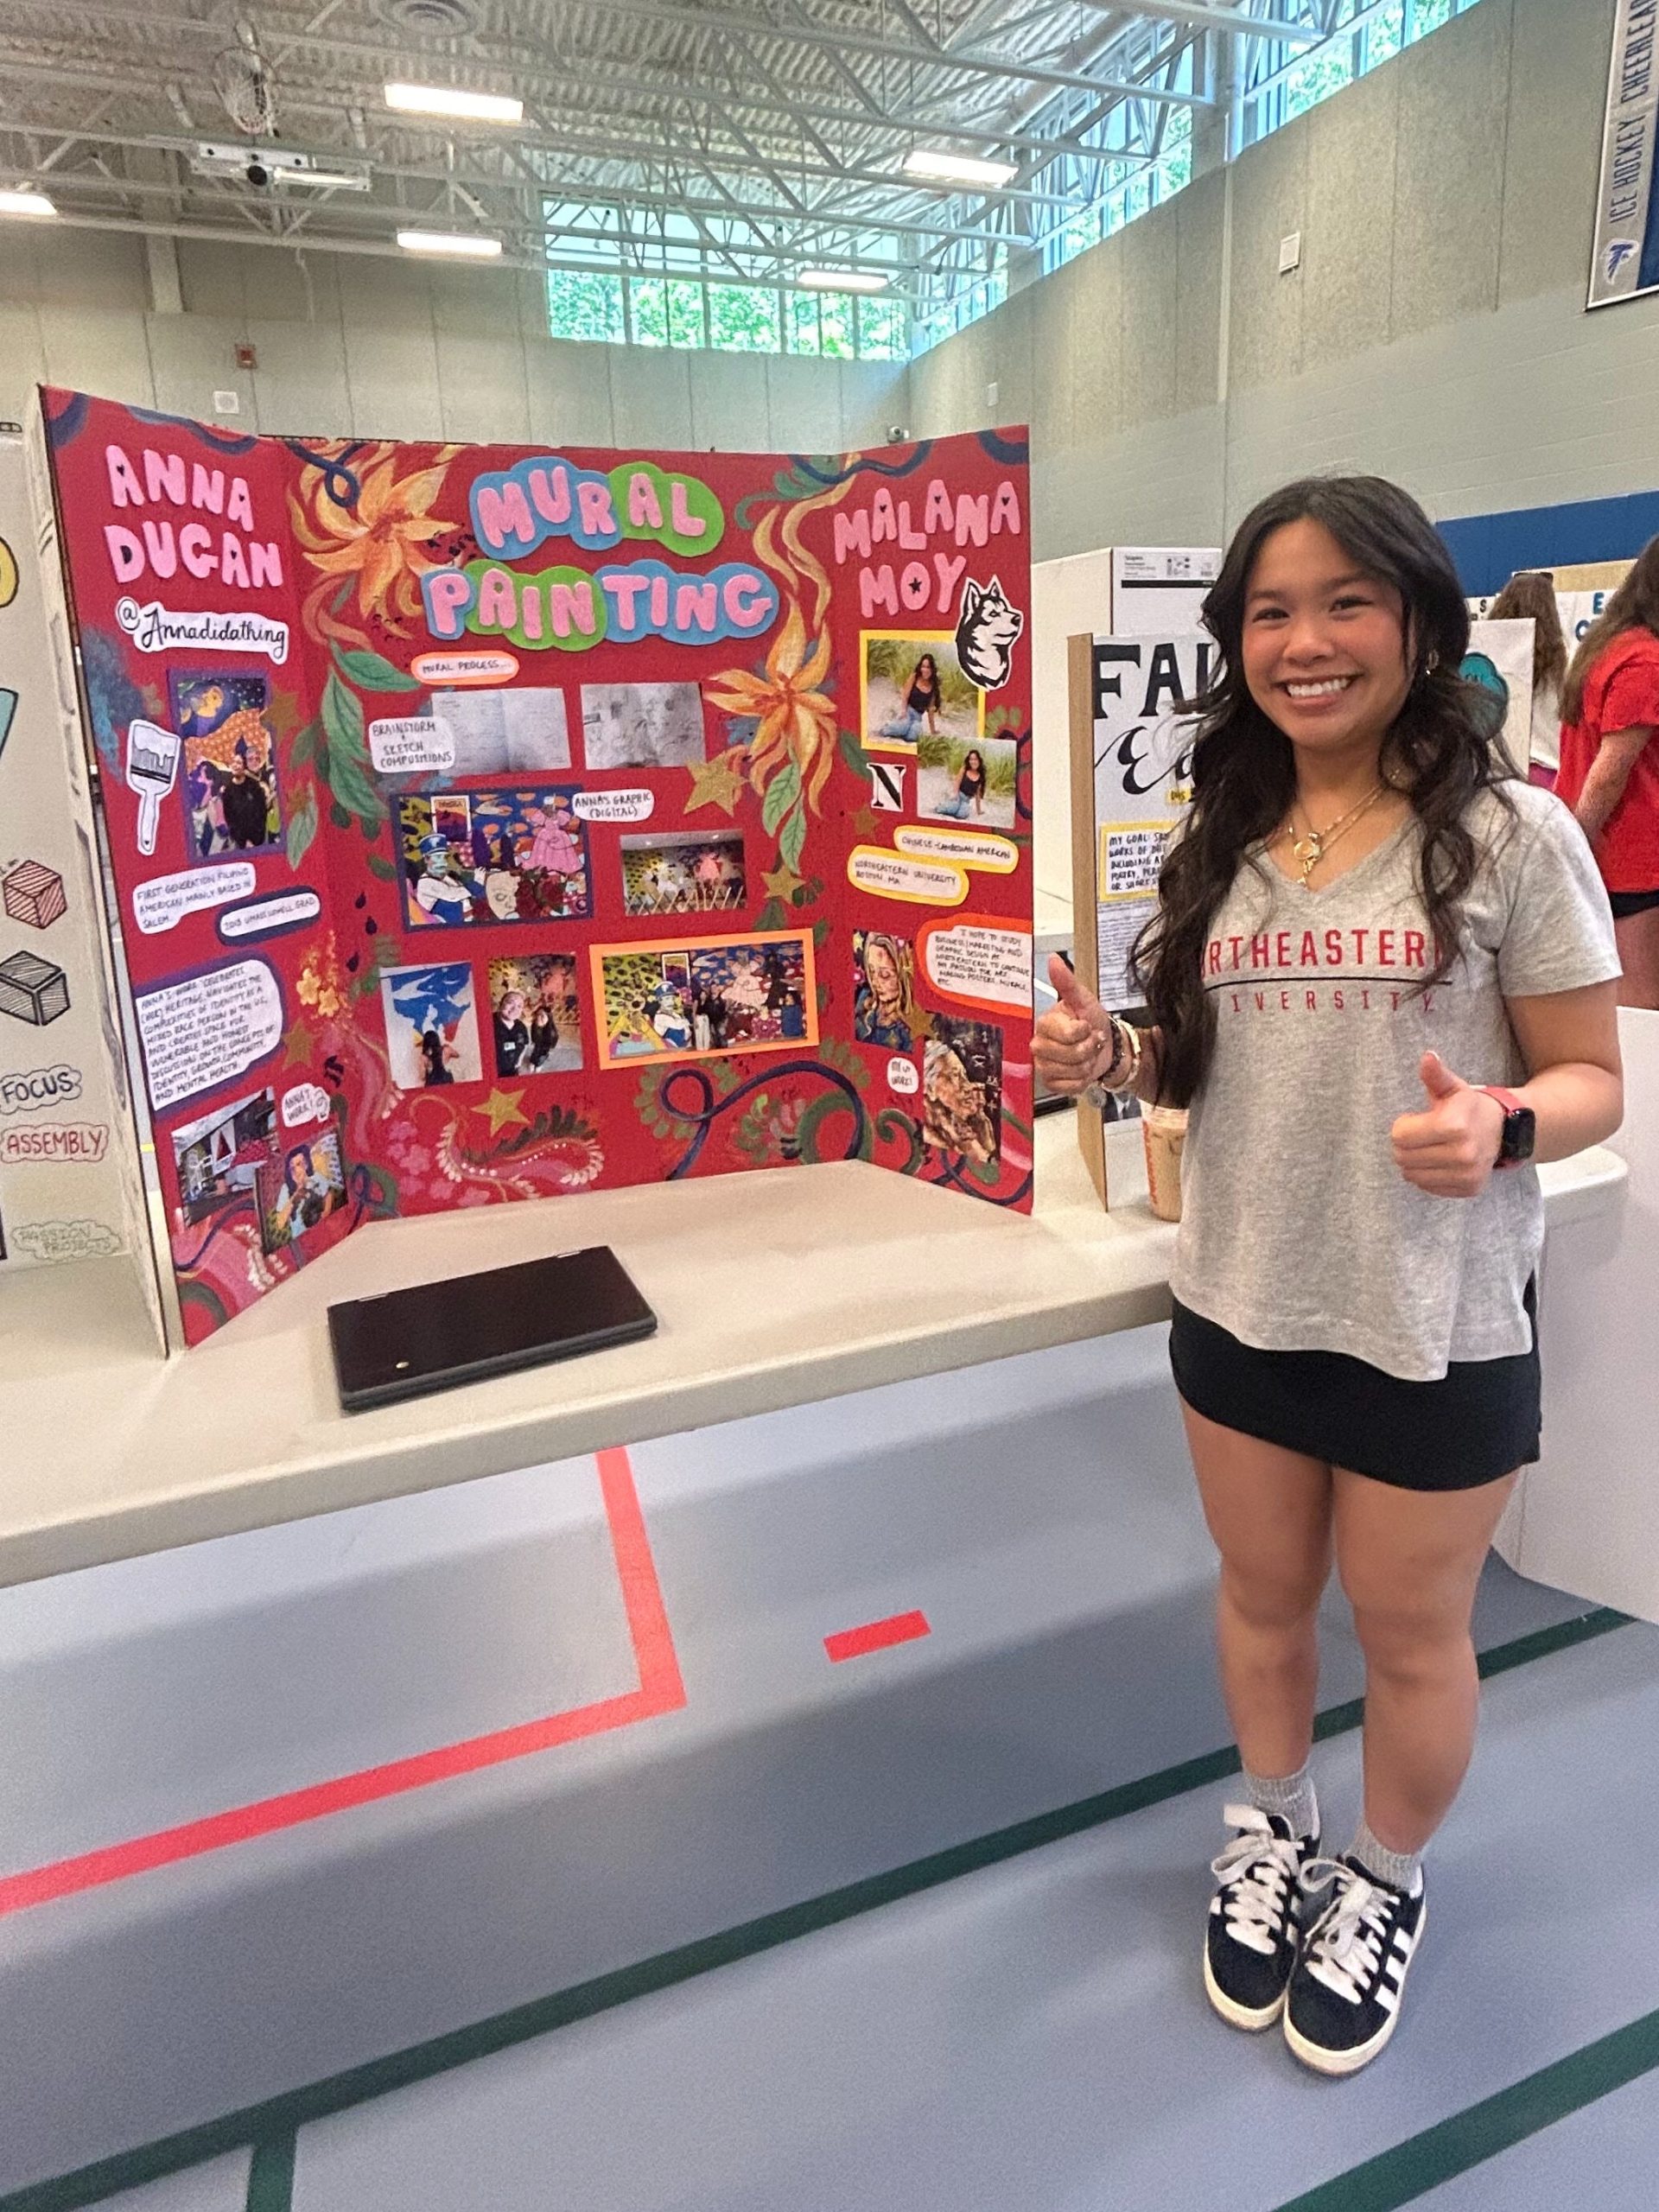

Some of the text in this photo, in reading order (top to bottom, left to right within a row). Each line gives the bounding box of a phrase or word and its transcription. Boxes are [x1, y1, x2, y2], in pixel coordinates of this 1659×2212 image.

[1612, 115, 1646, 189] HOCKEY
[1610, 189, 1638, 224] ICE
[105, 444, 254, 532] ANNA
[477, 466, 706, 549] MURAL
[834, 479, 1021, 564] MALANA
[104, 520, 283, 588] DUGAN
[859, 553, 967, 619] MOY
[429, 568, 772, 639] PAINTING
[423, 664, 453, 674] MURAL
[372, 721, 435, 737] BRAINSTORM
[380, 752, 453, 768] COMPOSITIONS
[383, 741, 423, 756] SKETCH
[868, 764, 906, 810] N
[575, 792, 652, 808] ANNA'S GRAPHIC
[589, 805, 639, 818] (DIGITAL)
[1109, 836, 1122, 846] MY
[1109, 847, 1133, 857] WORKS
[976, 847, 1011, 860] AMERICAN
[855, 861, 957, 885] NORTHEASTERN UNIVERSITY
[137, 887, 162, 900] FIRST
[165, 876, 216, 894] GENERATION
[139, 899, 182, 914] AMERICAN
[1201, 929, 1441, 976] RTHEASTER
[1231, 989, 1435, 1013] IVERSITY
[2, 1071, 74, 1103] FOCUS
[7, 1129, 103, 1155] ASSEMBLY
